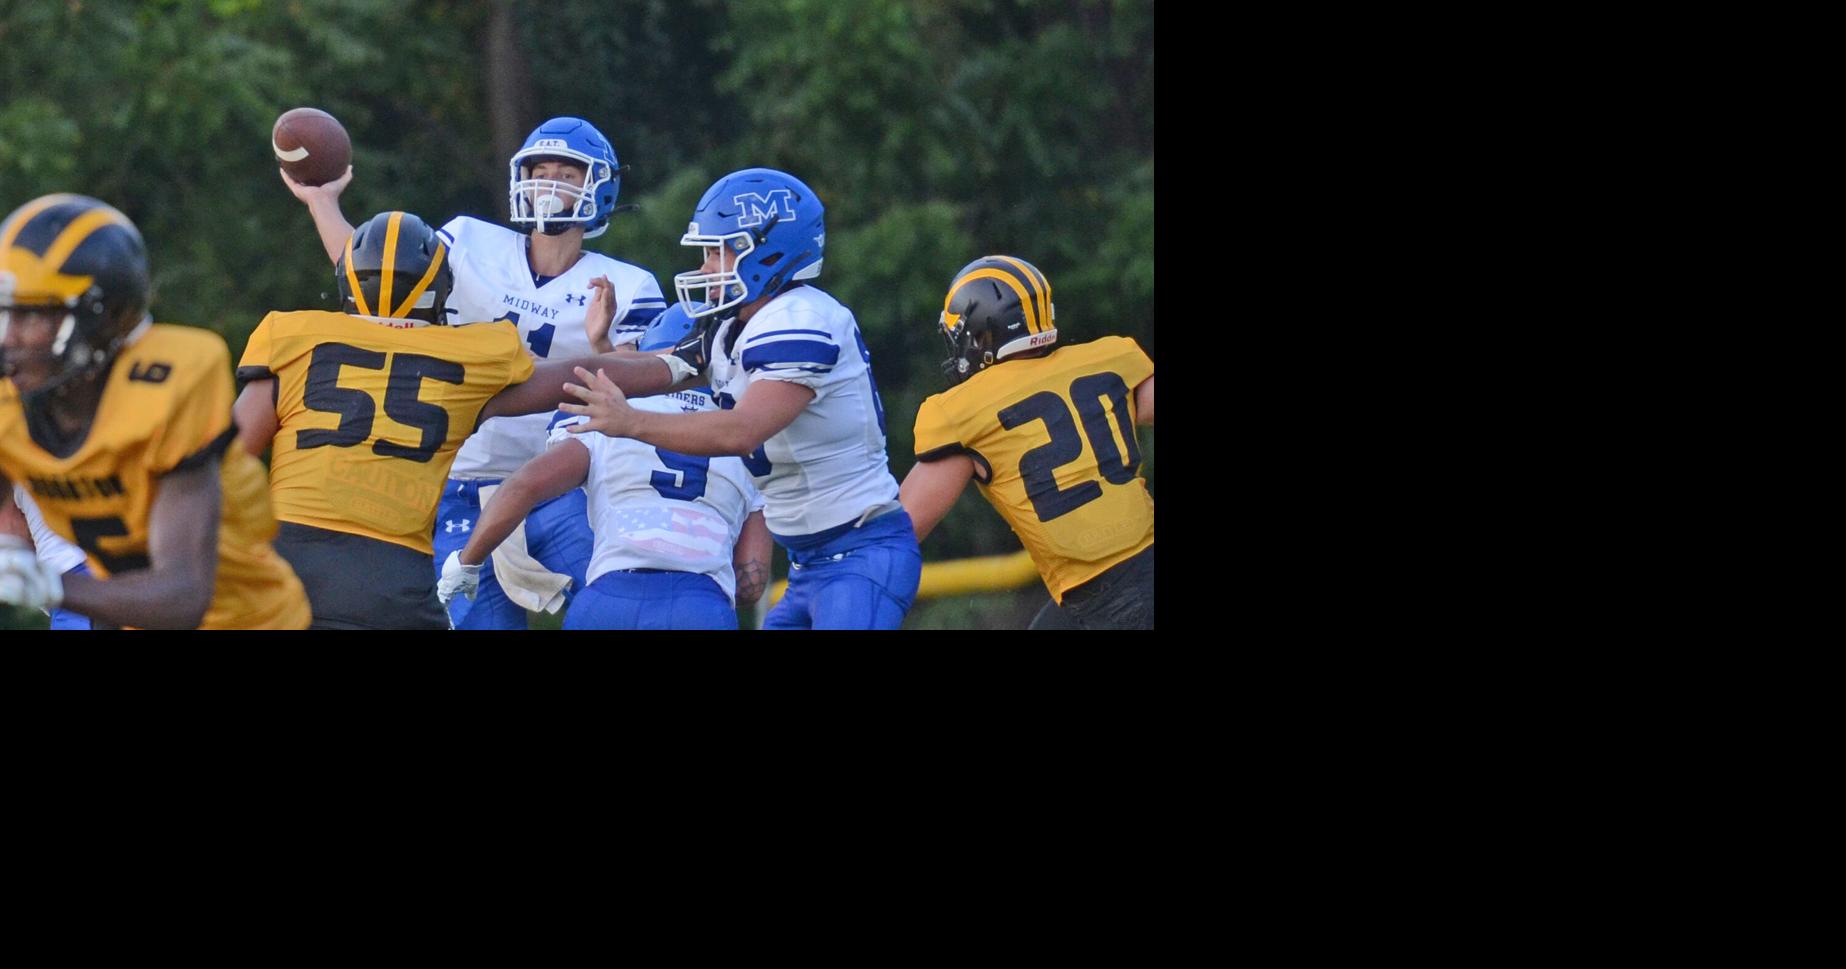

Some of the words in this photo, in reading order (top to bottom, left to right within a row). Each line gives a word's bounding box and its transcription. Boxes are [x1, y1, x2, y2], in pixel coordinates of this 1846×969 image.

[734, 189, 796, 228] M
[503, 294, 559, 320] MIDWAY
[296, 342, 465, 463] 55
[997, 371, 1142, 523] 20
